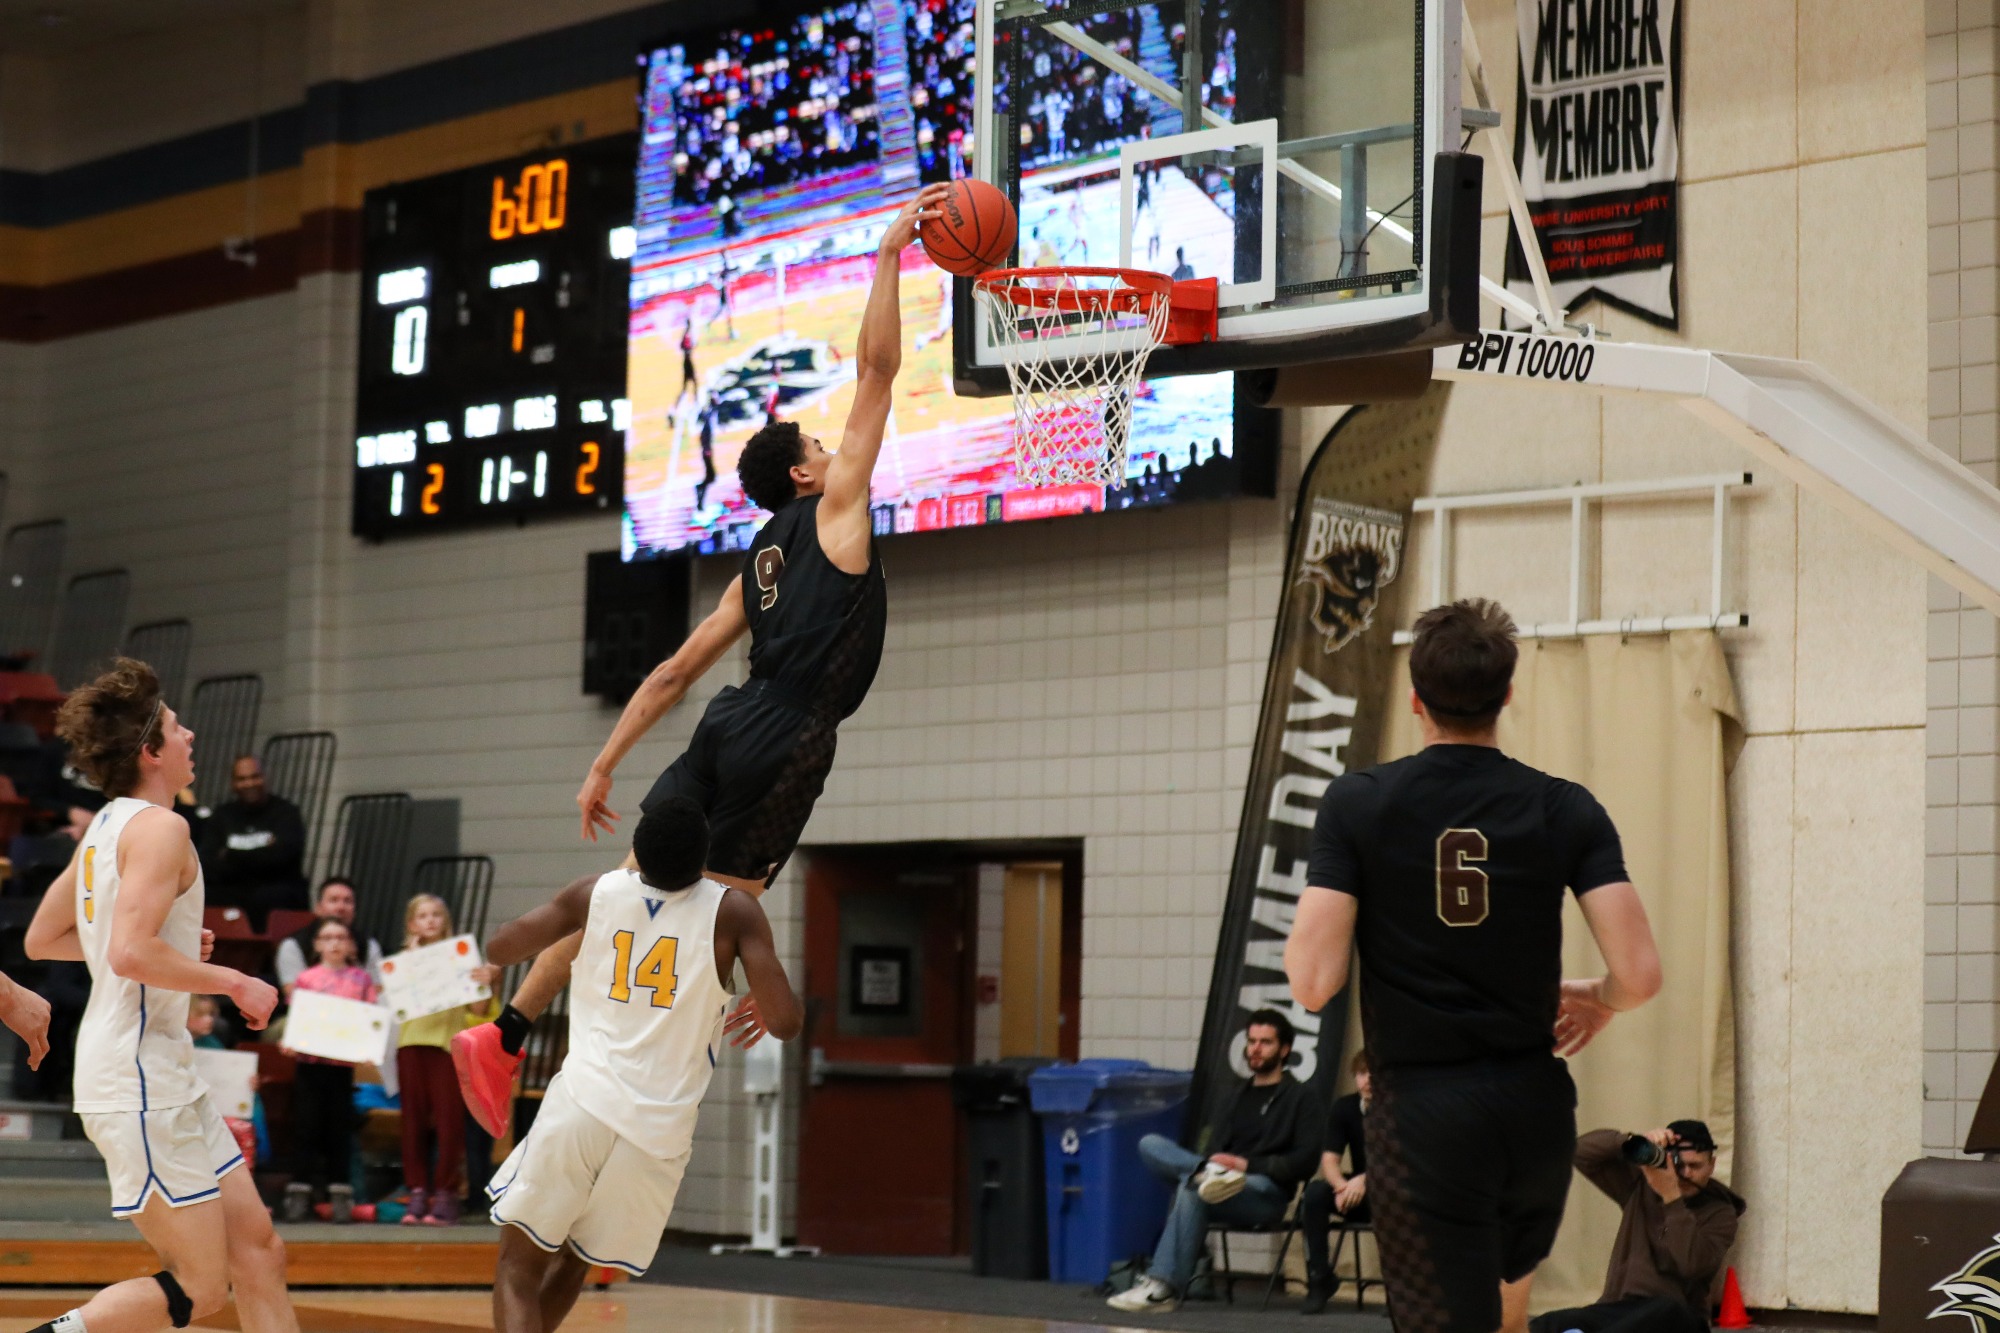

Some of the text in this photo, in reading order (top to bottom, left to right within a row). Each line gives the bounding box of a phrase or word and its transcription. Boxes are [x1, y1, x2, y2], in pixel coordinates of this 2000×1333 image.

[1532, 0, 1664, 86] MEMBER
[1457, 333, 1595, 382] BPI 10000
[421, 463, 444, 514] 2
[575, 441, 600, 494] 2
[755, 544, 785, 611] 9
[1304, 512, 1402, 579] BISONS
[642, 896, 666, 921] V
[1436, 828, 1489, 927] 6
[608, 929, 679, 1010] 14
